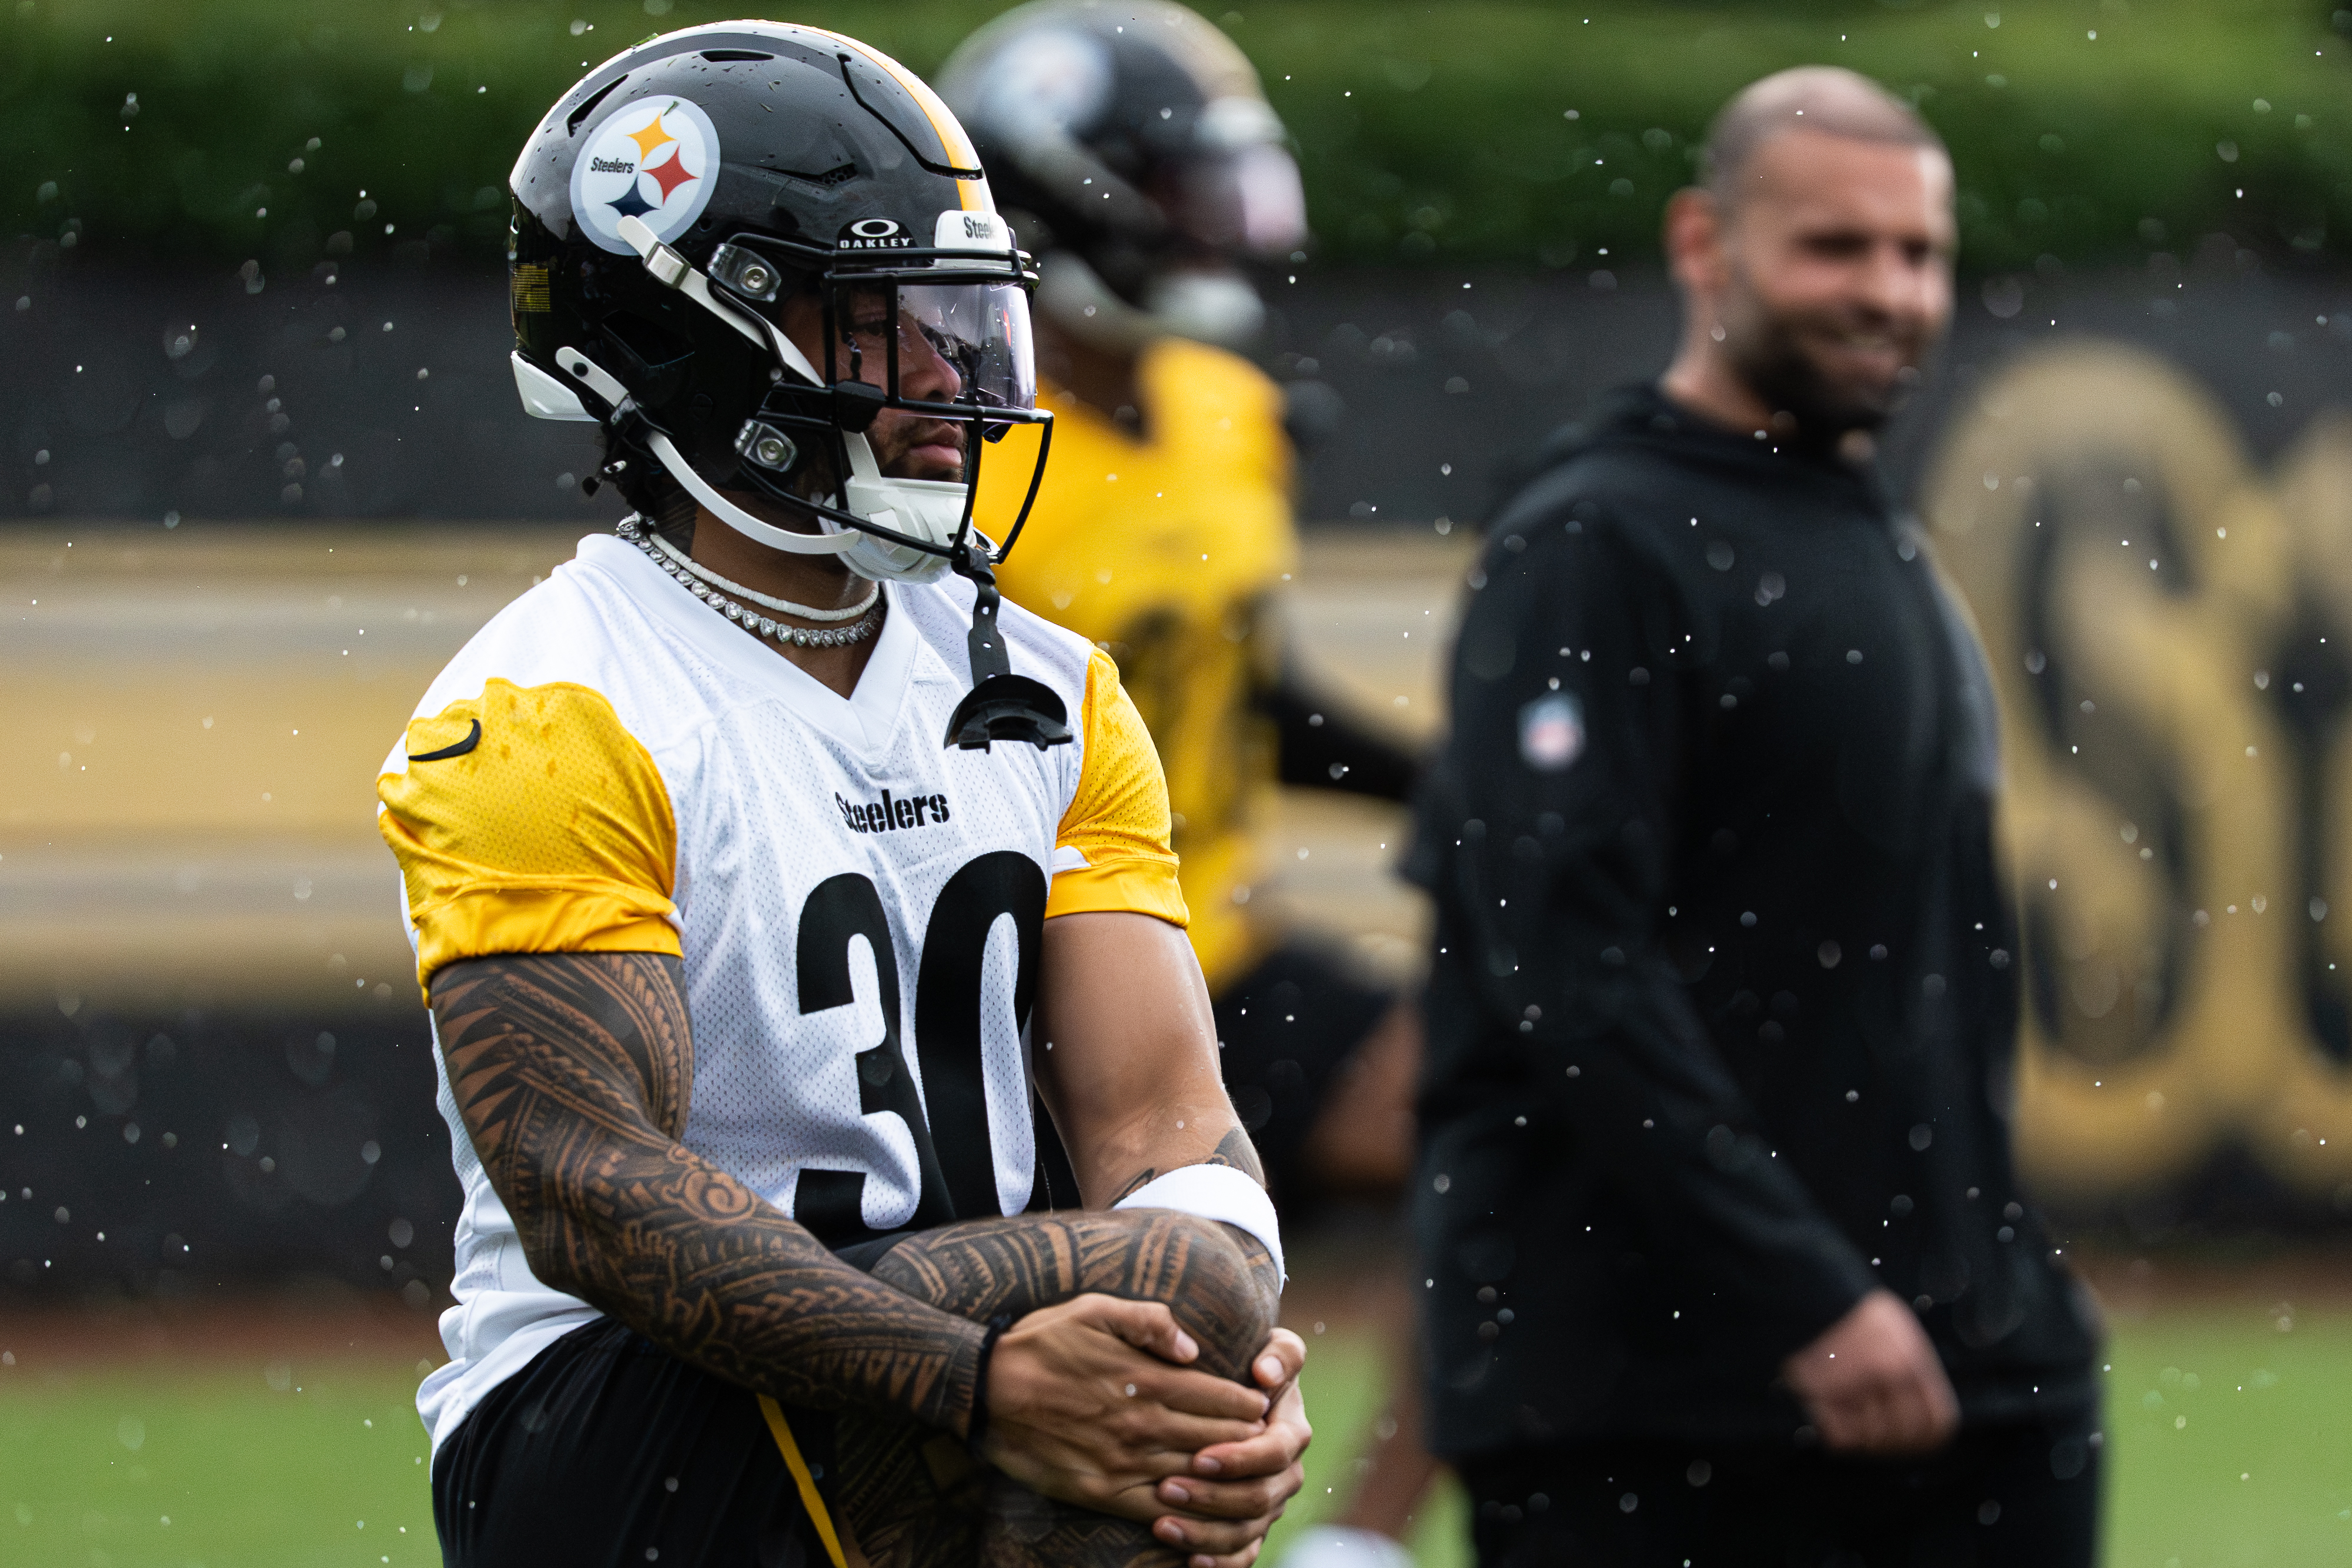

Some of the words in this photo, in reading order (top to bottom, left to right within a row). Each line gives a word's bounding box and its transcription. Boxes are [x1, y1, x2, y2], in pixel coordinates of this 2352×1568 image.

[590, 157, 634, 173] Steelers
[840, 238, 910, 248] OAKLEY
[835, 789, 950, 833] Steelers
[794, 850, 1048, 1245] 30
